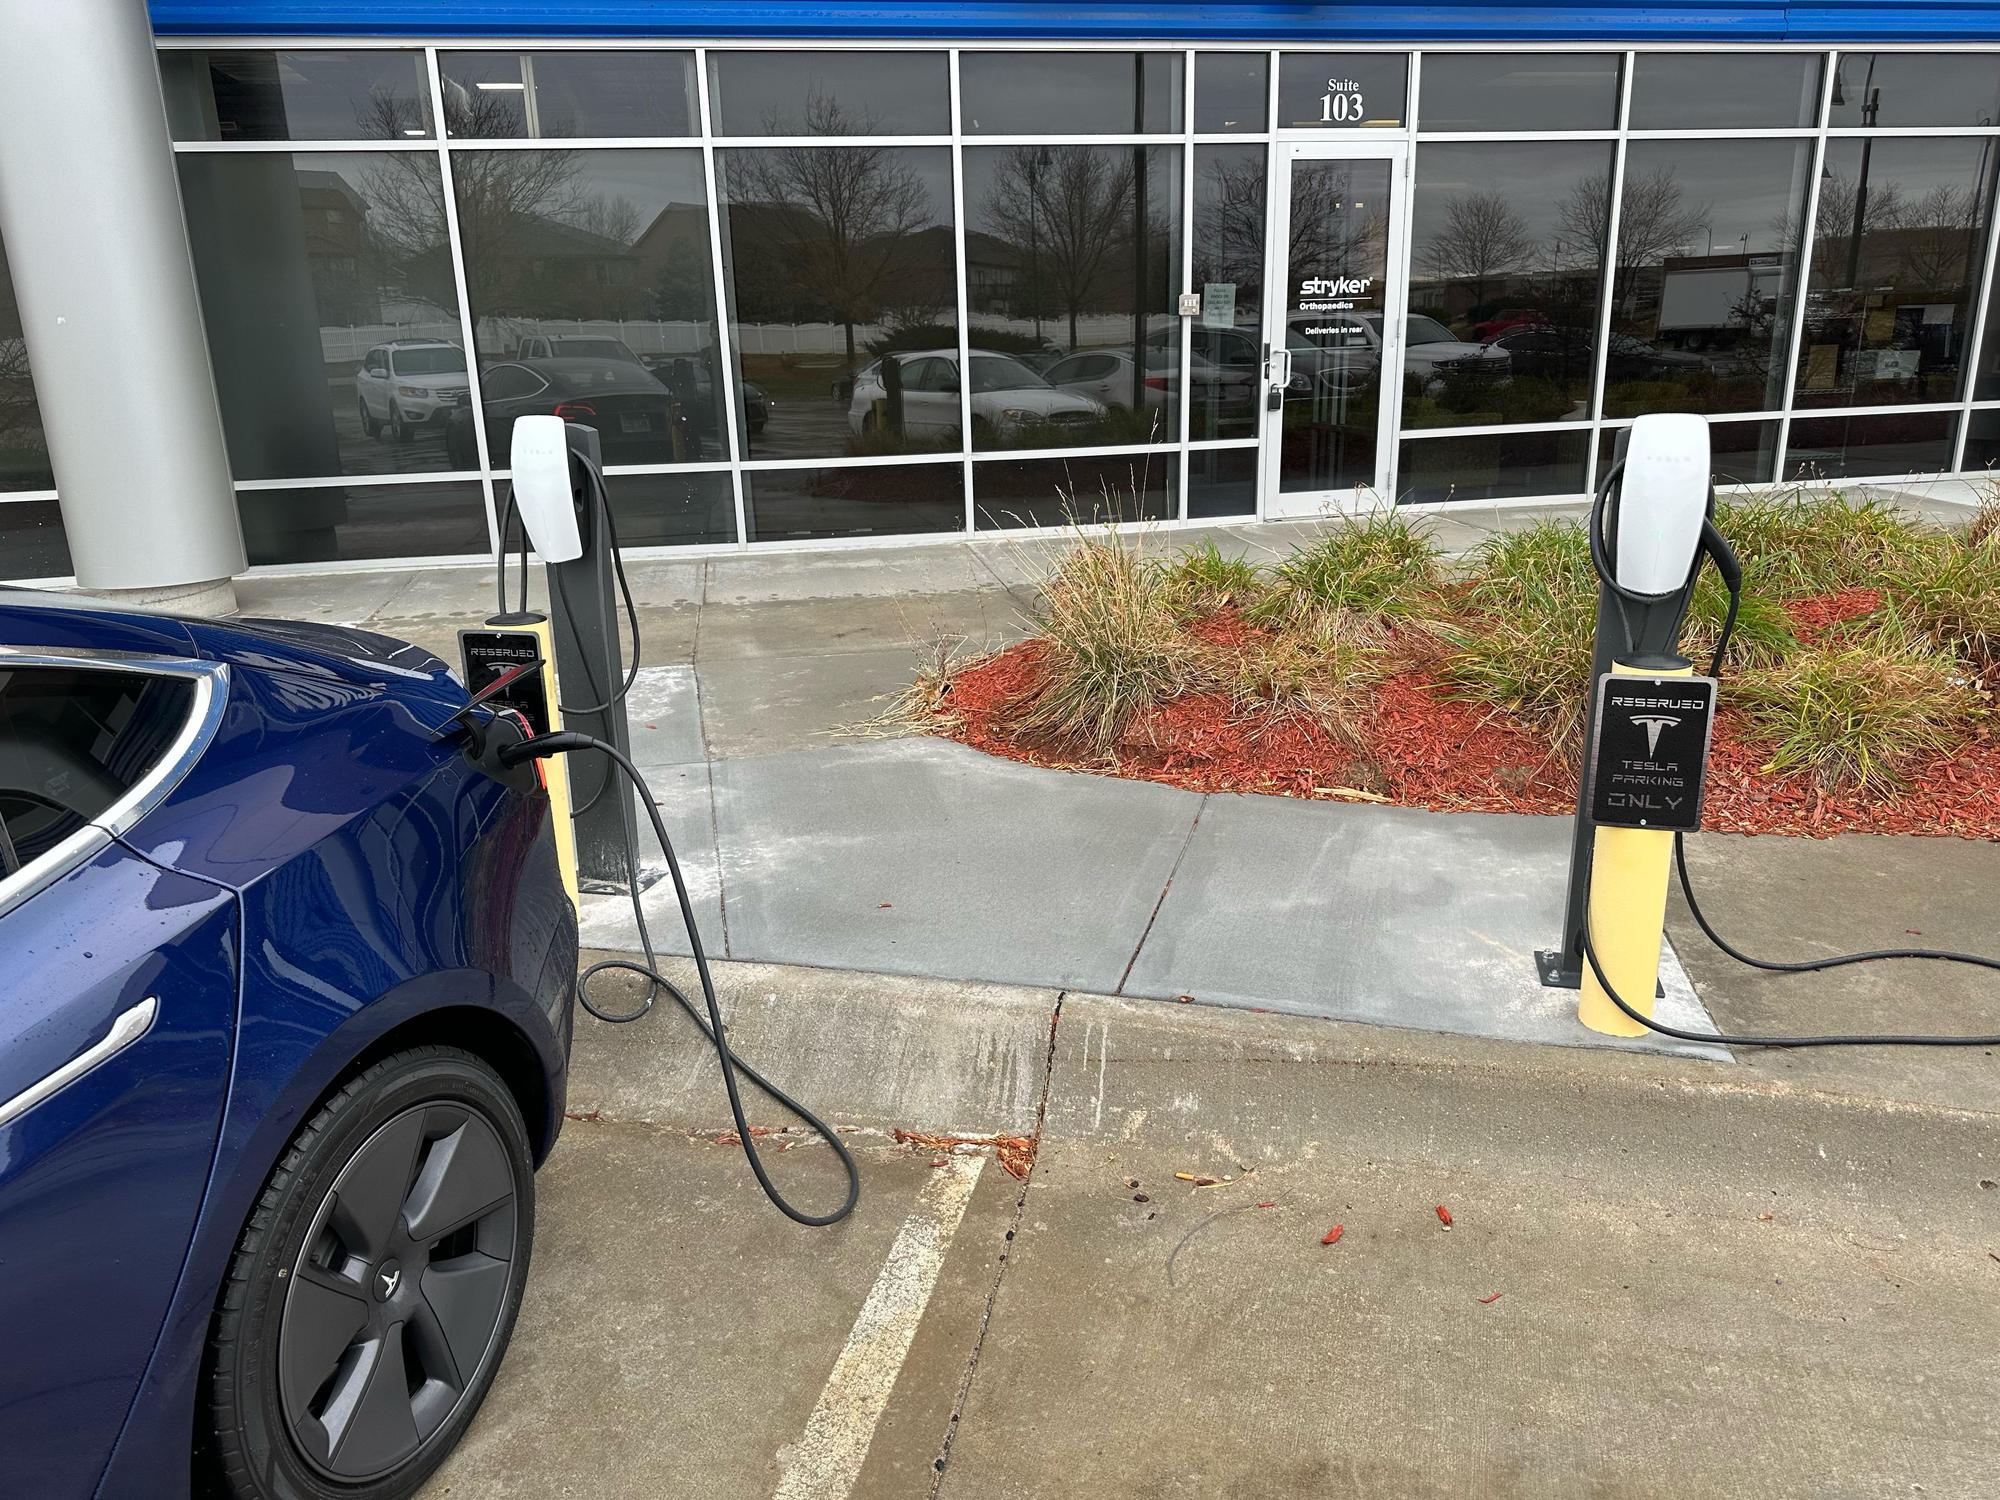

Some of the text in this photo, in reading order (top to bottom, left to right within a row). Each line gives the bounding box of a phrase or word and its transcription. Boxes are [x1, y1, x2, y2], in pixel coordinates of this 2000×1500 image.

[1328, 78, 1360, 91] Suite
[1320, 93, 1364, 121] 103
[1300, 276, 1371, 297] stryker
[1299, 302, 1354, 311] Orthopaedics
[1305, 326, 1364, 335] Deliveries in rear
[1621, 760, 1679, 772] TESLA
[1612, 774, 1684, 788] PARKING
[1607, 792, 1683, 810] ONLY
